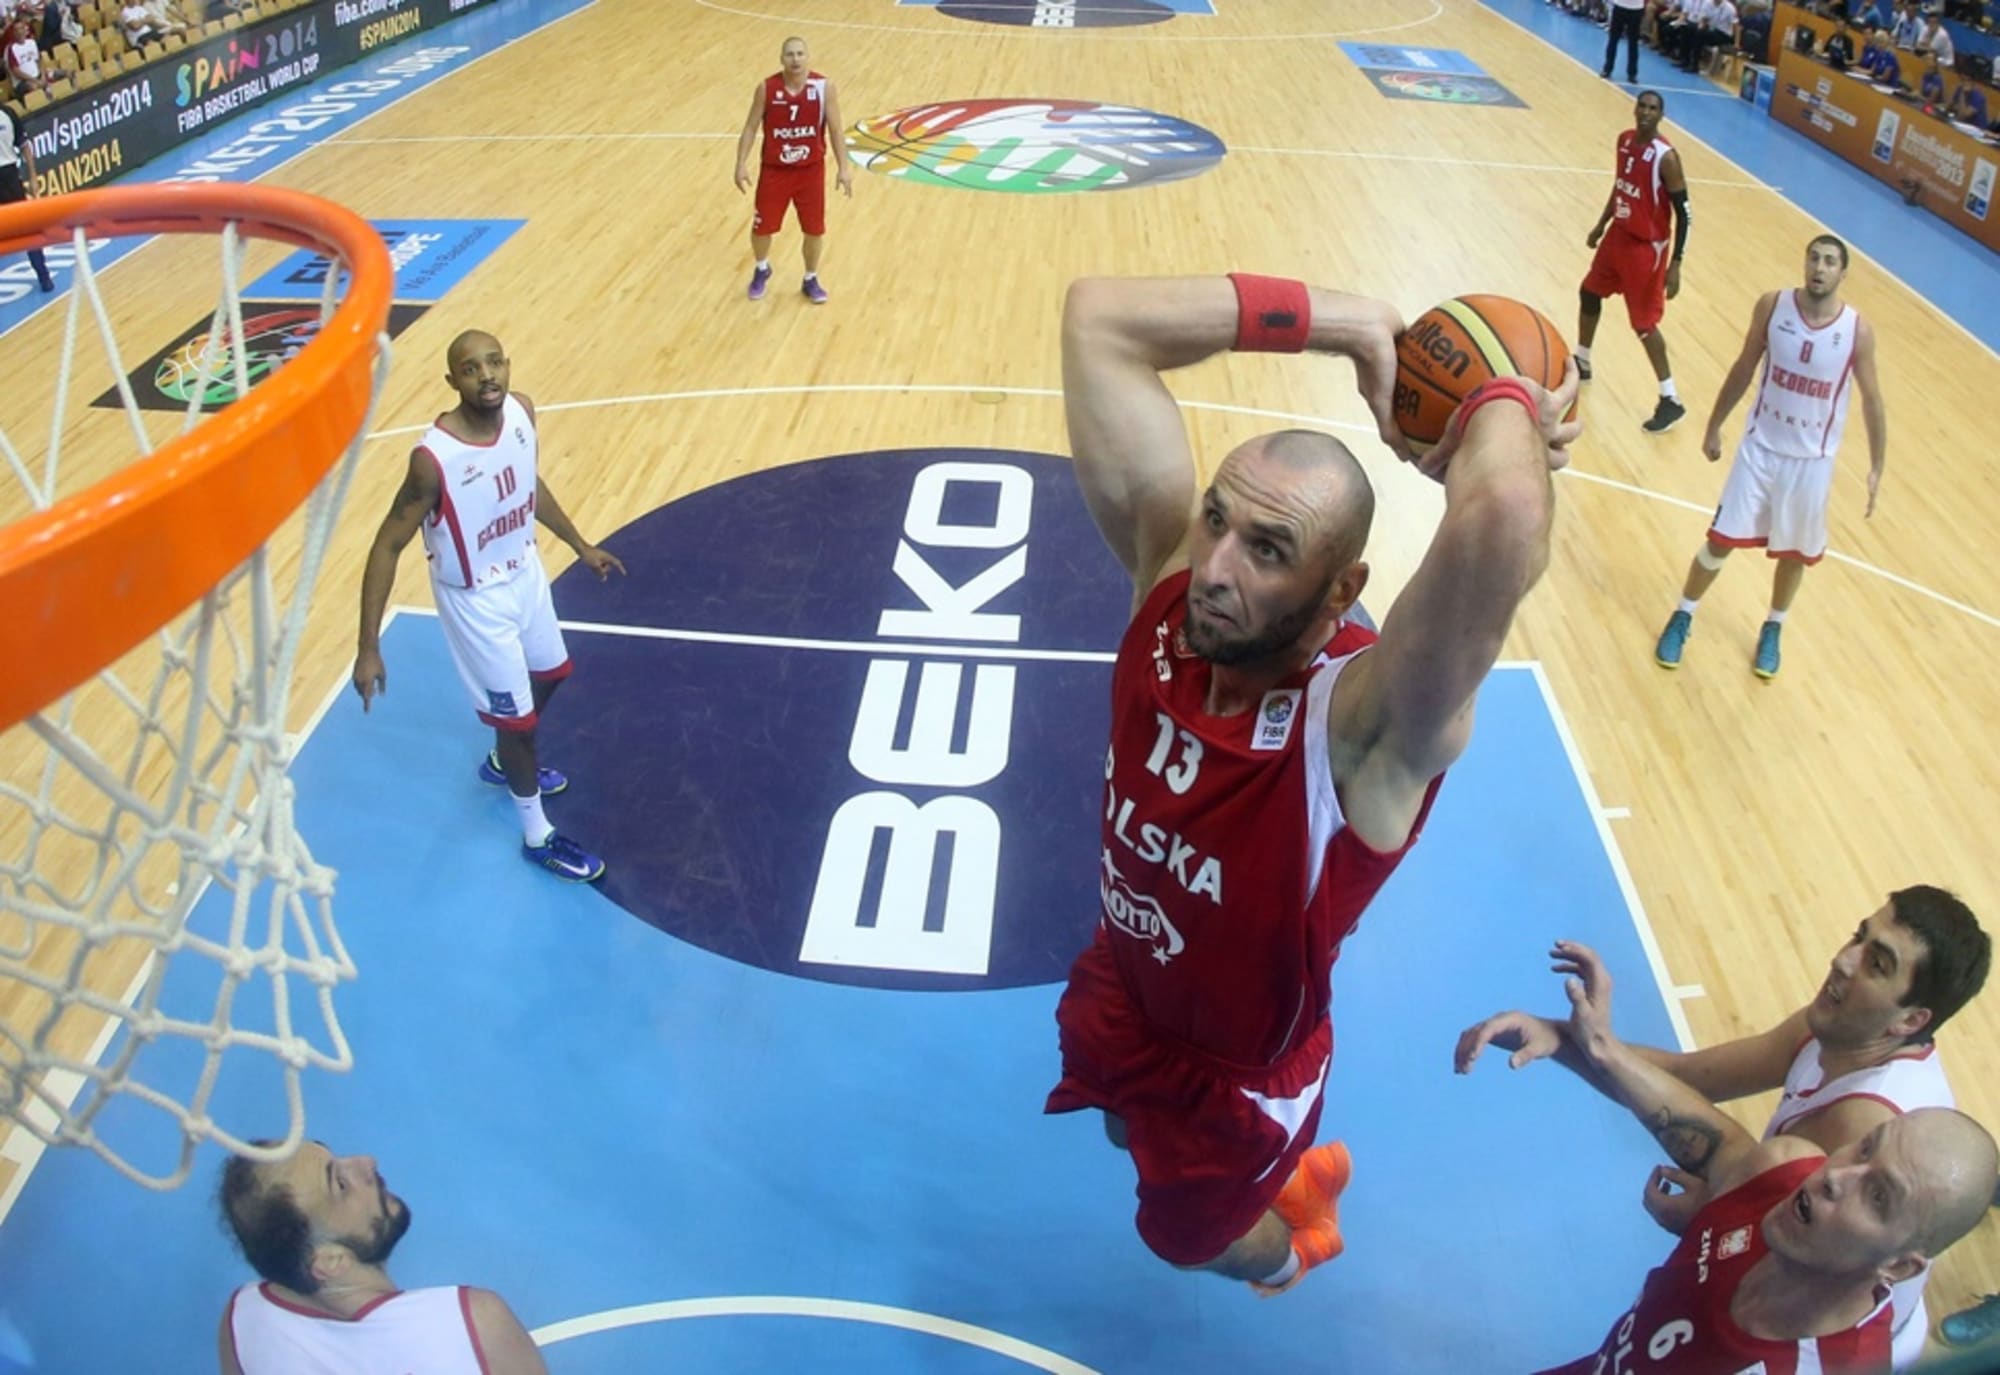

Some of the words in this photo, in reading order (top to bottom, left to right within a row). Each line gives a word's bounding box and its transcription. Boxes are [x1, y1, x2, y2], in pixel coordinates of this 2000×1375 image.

[266, 15, 317, 65] 2014
[360, 7, 420, 50] #SPAIN2014
[177, 105, 203, 133] FIBA
[204, 76, 268, 121] BASKETBALL
[267, 61, 301, 90] WORLD
[302, 53, 320, 75] CUP
[789, 104, 799, 121] 7
[773, 125, 816, 138] POLSKA
[1771, 364, 1832, 401] GEORGIA
[494, 465, 517, 503] 10
[799, 462, 1034, 975] BEKO
[1144, 712, 1204, 794] 13
[1104, 886, 1161, 938] OTTO
[1648, 1319, 1694, 1360] 6
